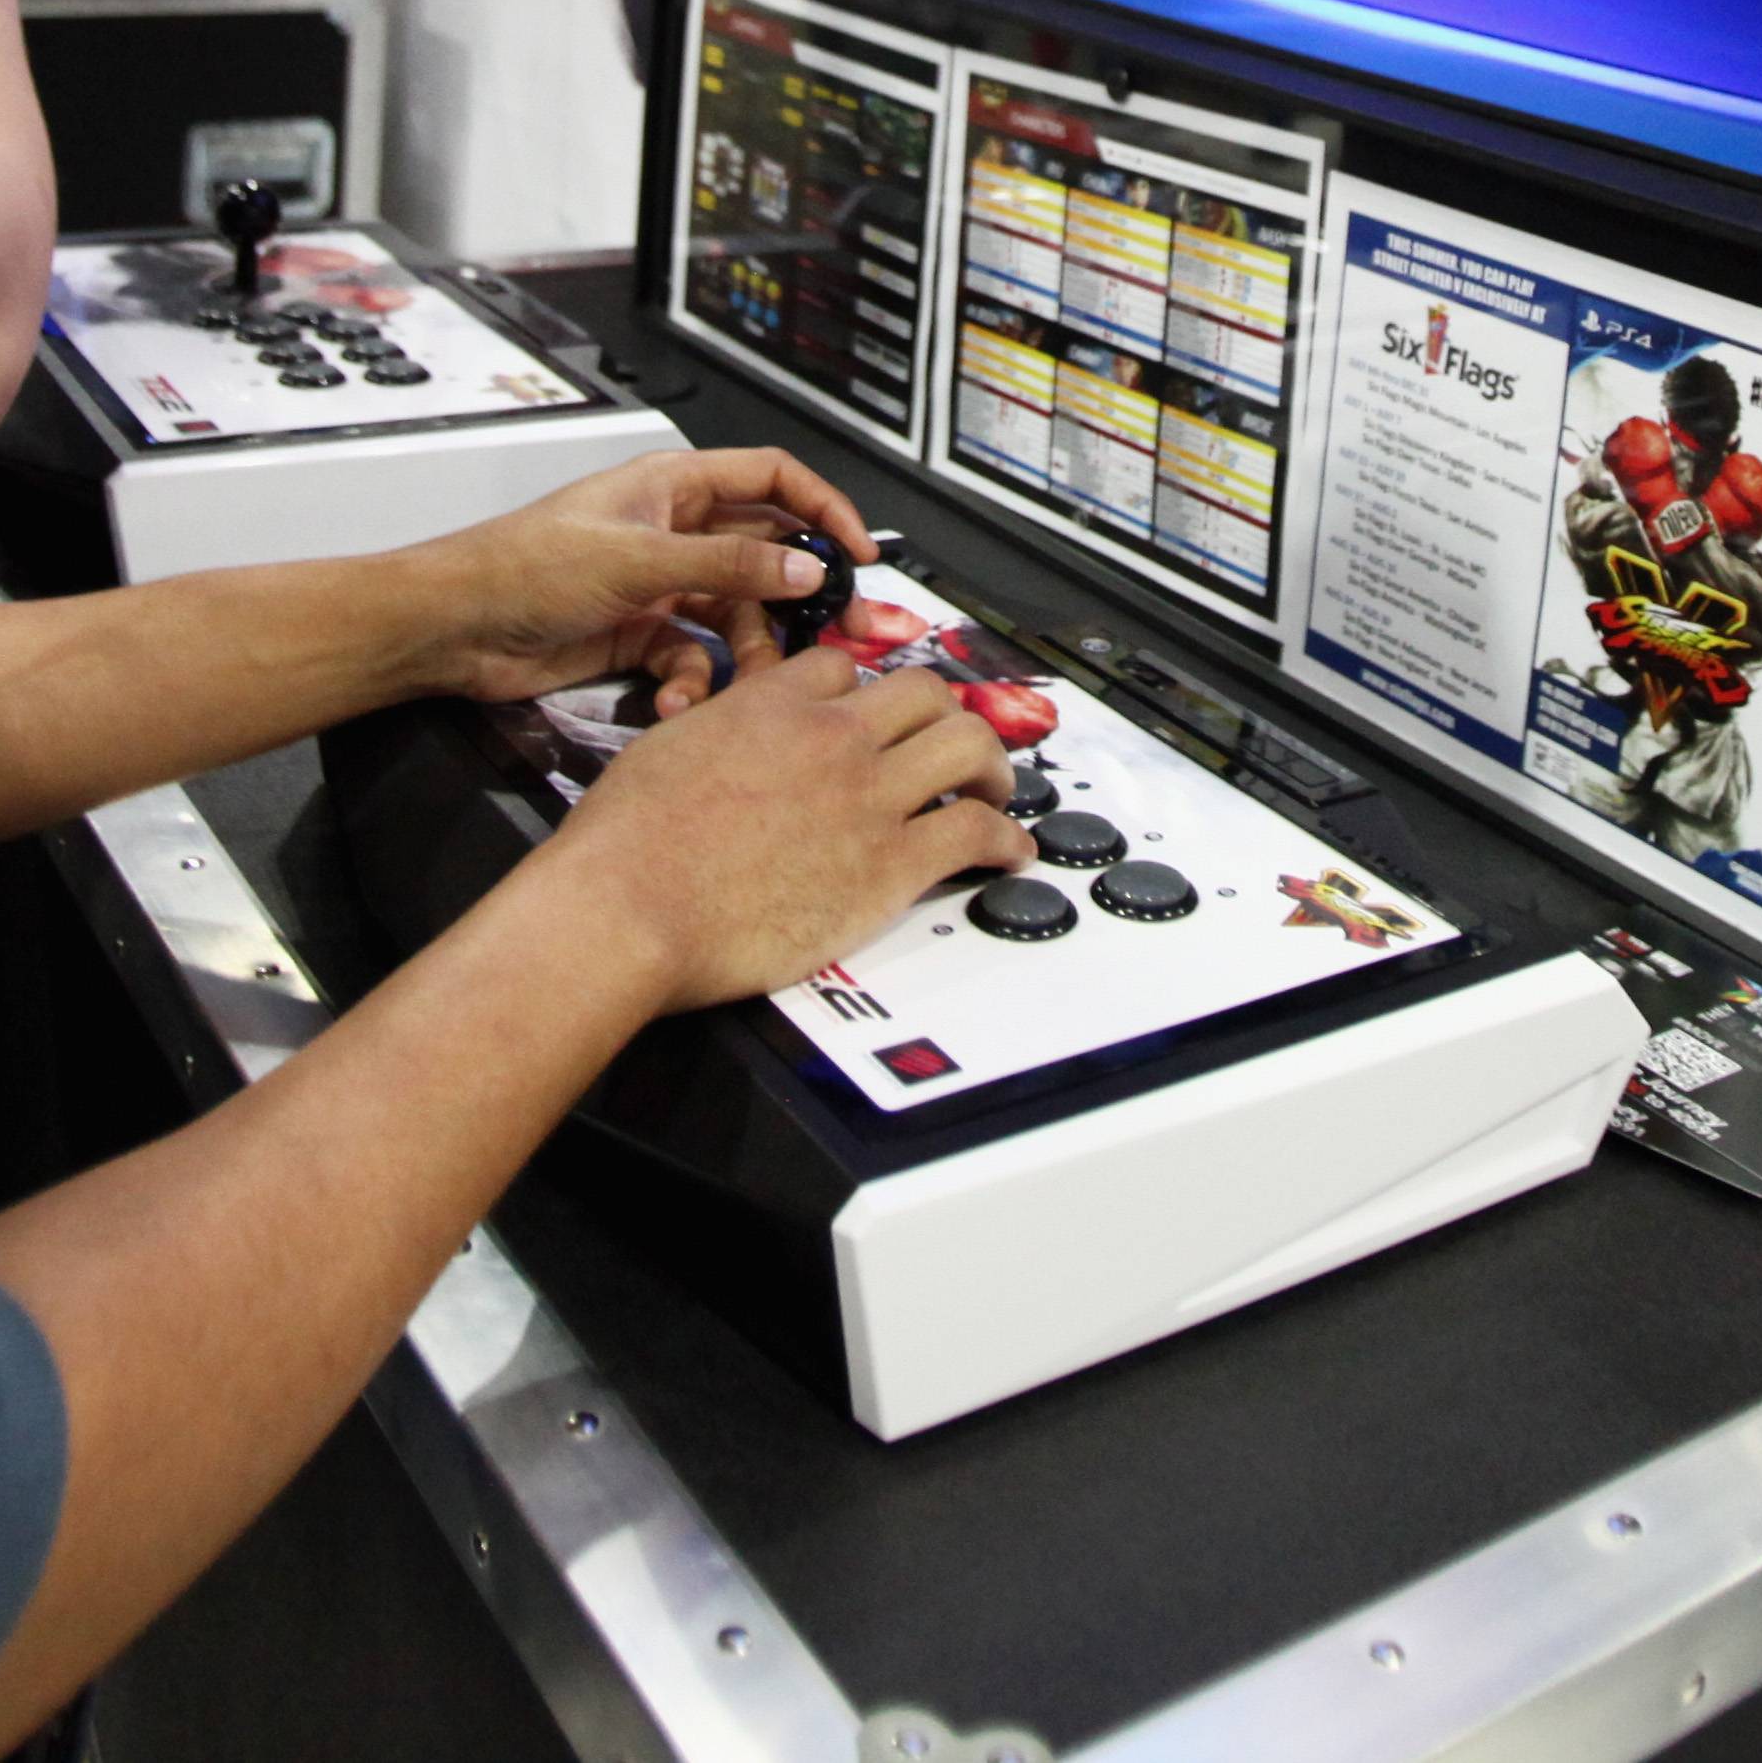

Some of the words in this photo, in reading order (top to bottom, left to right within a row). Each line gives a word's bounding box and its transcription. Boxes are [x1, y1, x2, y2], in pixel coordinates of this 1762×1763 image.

[1371, 248, 1410, 276] STREET
[1409, 261, 1453, 291] FIGHTER
[1452, 276, 1462, 294] V
[1461, 279, 1531, 318] EXCLUSIVELY
[1530, 302, 1547, 324] AT
[1386, 233, 1413, 255] THIS
[1461, 258, 1484, 280] YOU
[1483, 265, 1508, 288] CAN
[1507, 273, 1535, 297] PLAY
[1381, 322, 1425, 365] Six
[1443, 346, 1517, 400] Flags
[1605, 320, 1653, 350] PS4
